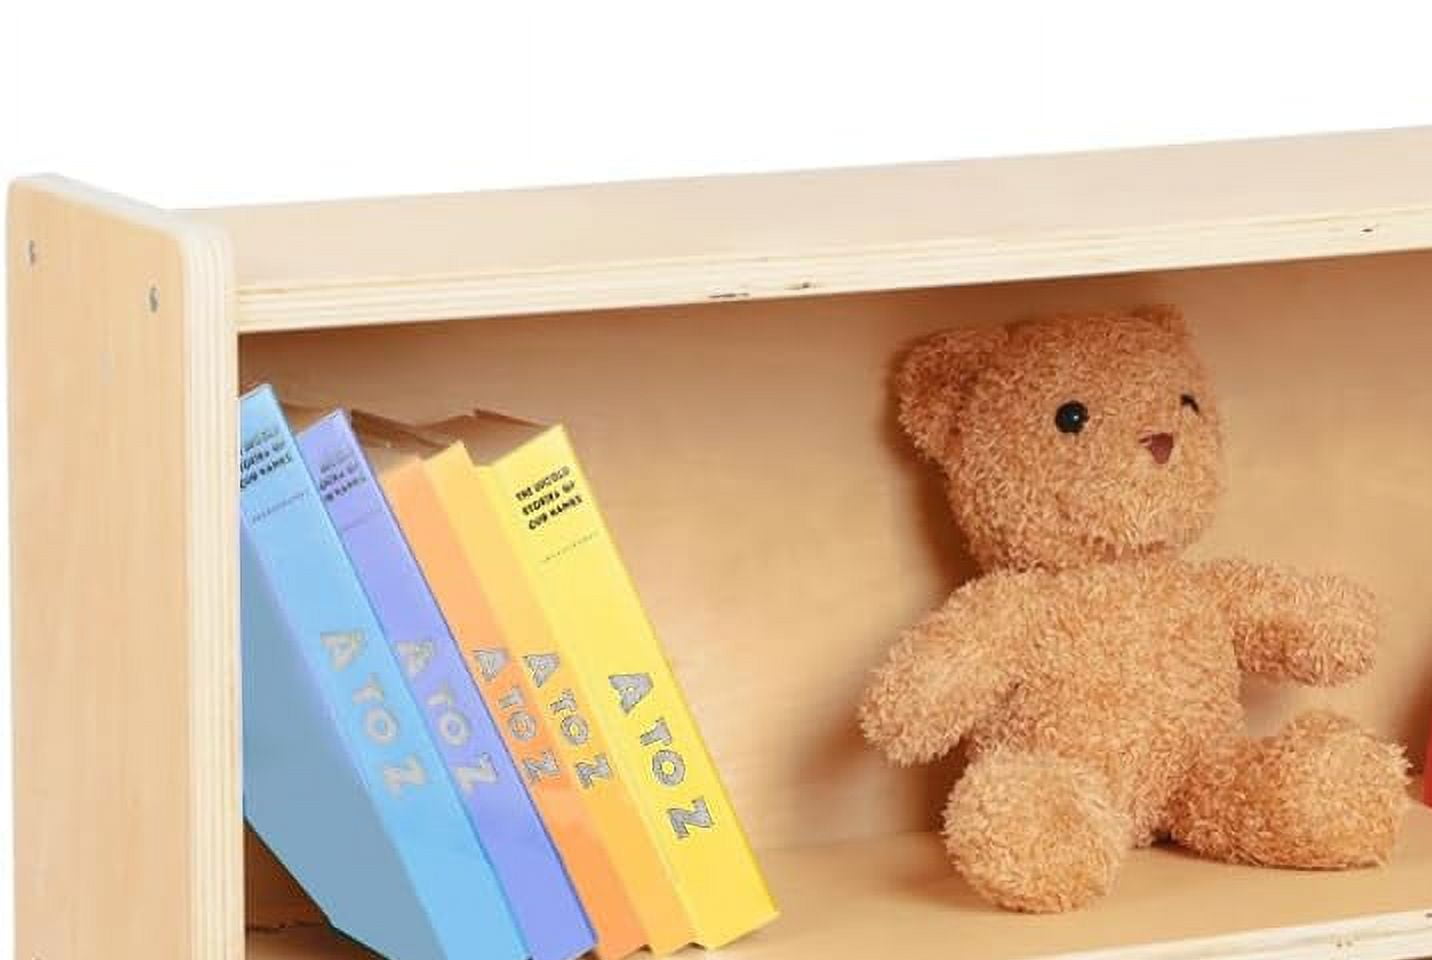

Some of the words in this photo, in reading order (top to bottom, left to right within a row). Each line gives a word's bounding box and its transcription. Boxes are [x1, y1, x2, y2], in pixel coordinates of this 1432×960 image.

[320, 630, 366, 673] A
[352, 672, 399, 746] TO
[381, 753, 427, 798] Z
[394, 640, 438, 680] A
[426, 683, 472, 747] TO
[452, 751, 498, 793] Z
[473, 649, 508, 682] A
[499, 685, 537, 741] TO
[522, 750, 561, 783] Z
[523, 652, 560, 688] A
[550, 689, 589, 745] TO
[575, 752, 612, 788] Z
[608, 672, 654, 714] A
[639, 716, 686, 786] TO
[667, 796, 715, 839] Z
